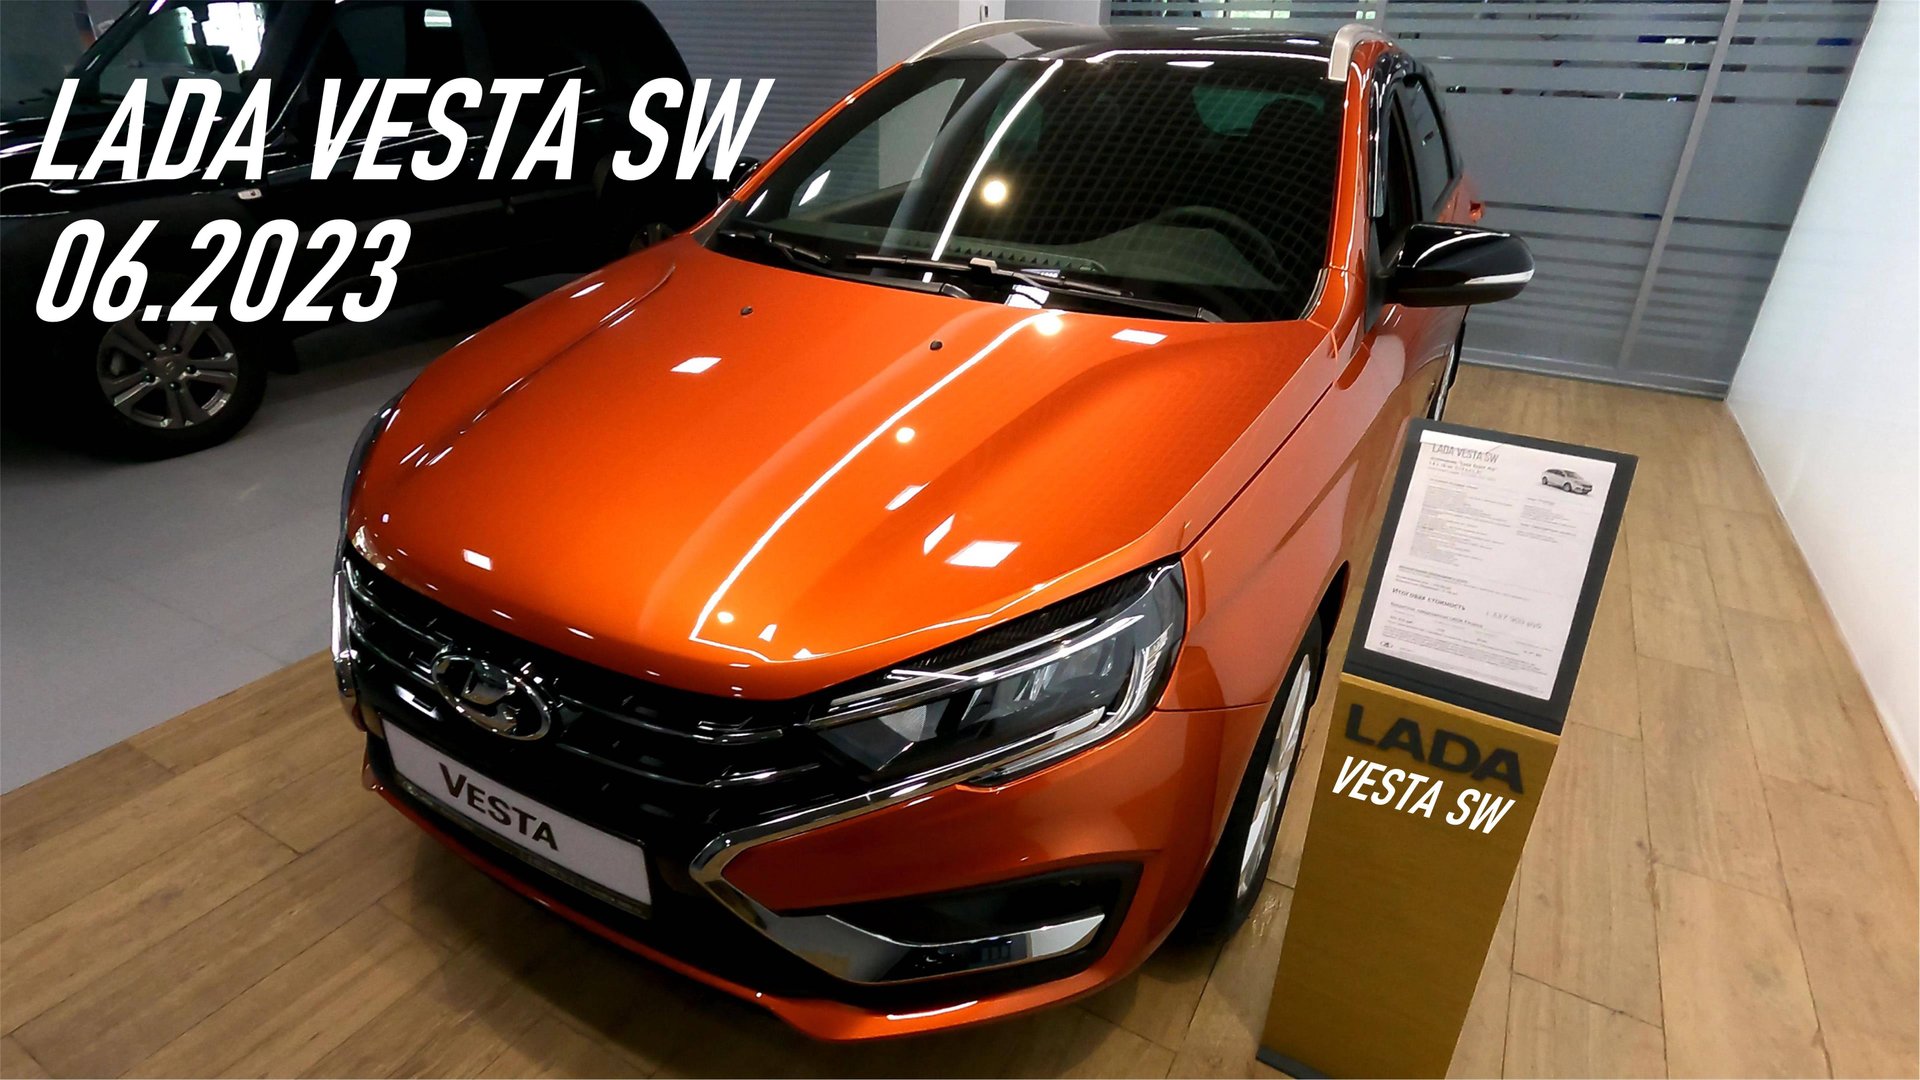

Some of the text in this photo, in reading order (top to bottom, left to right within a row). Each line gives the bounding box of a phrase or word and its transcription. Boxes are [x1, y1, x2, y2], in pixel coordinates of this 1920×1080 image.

[1432, 443, 1499, 463] LADA VESTA SW
[1344, 703, 1525, 795] LADA
[438, 761, 559, 852] VESTA
